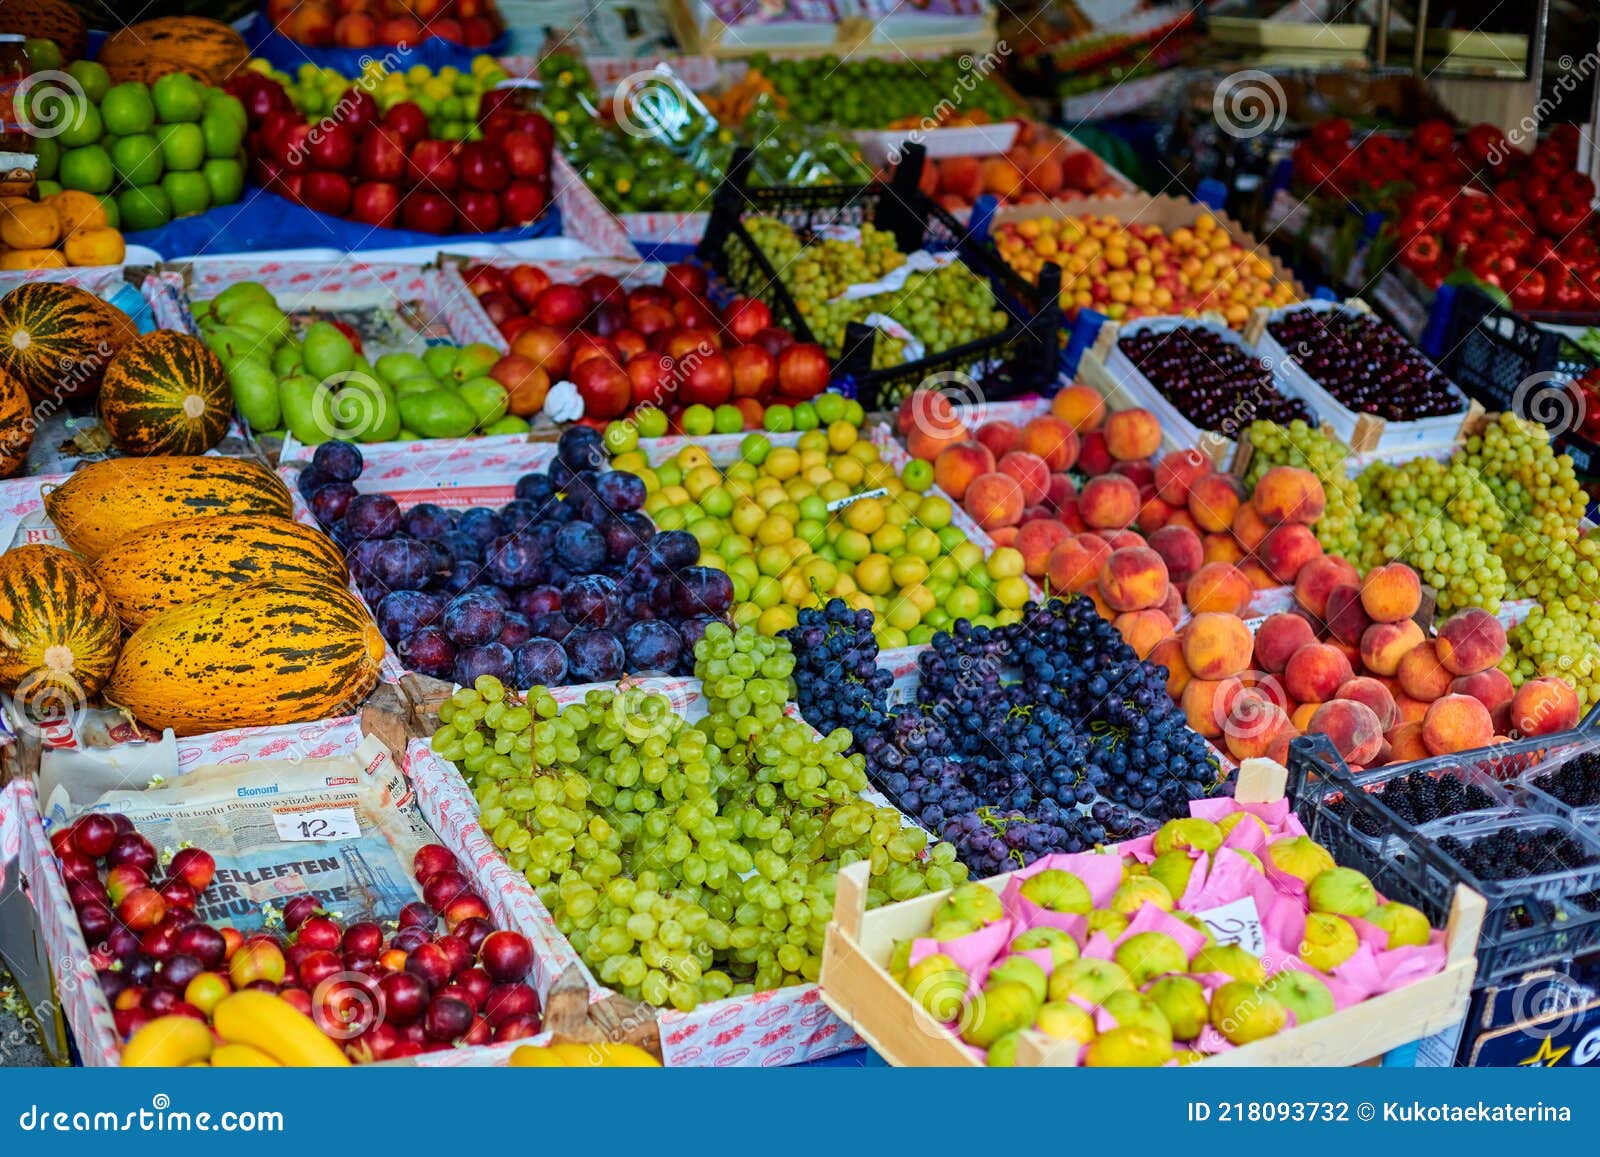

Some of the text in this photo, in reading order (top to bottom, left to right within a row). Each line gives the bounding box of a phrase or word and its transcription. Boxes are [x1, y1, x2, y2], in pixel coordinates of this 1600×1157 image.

[237, 783, 279, 797] Ekonomi
[193, 806, 224, 817] toplu
[334, 791, 358, 800] zam
